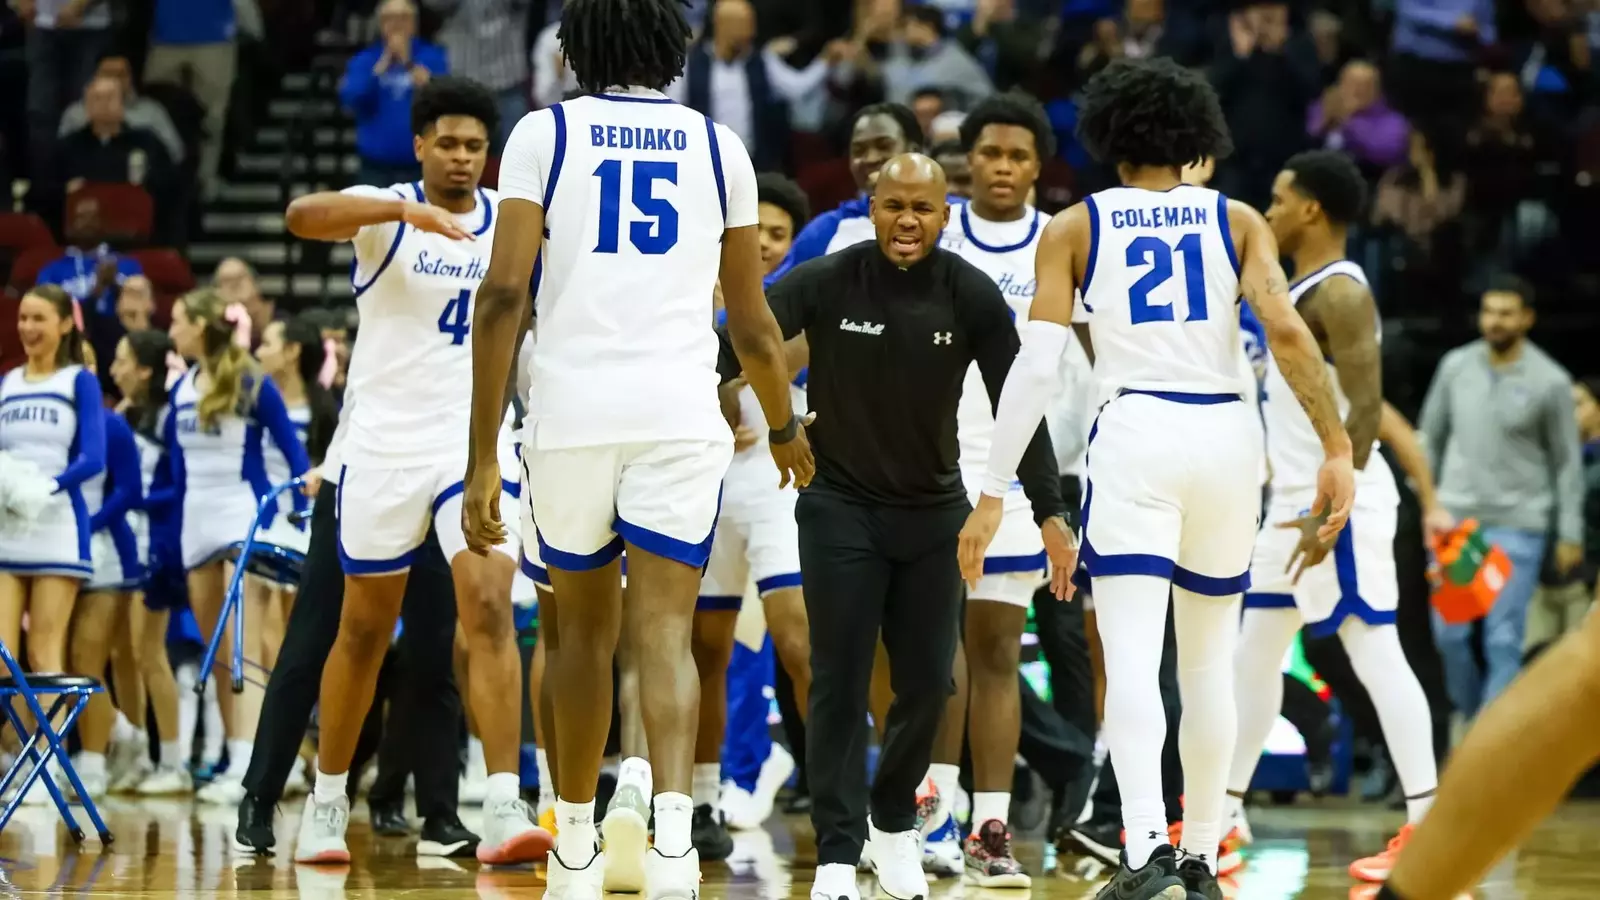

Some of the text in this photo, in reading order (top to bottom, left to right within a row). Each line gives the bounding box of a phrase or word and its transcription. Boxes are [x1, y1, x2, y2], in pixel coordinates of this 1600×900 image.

[589, 124, 687, 151] BEDIAKO
[591, 159, 679, 255] 15
[1111, 206, 1207, 229] COLEMAN
[413, 249, 463, 277] Seton
[998, 272, 1037, 297] Hal
[1125, 233, 1208, 325] 21
[437, 288, 472, 346] 4
